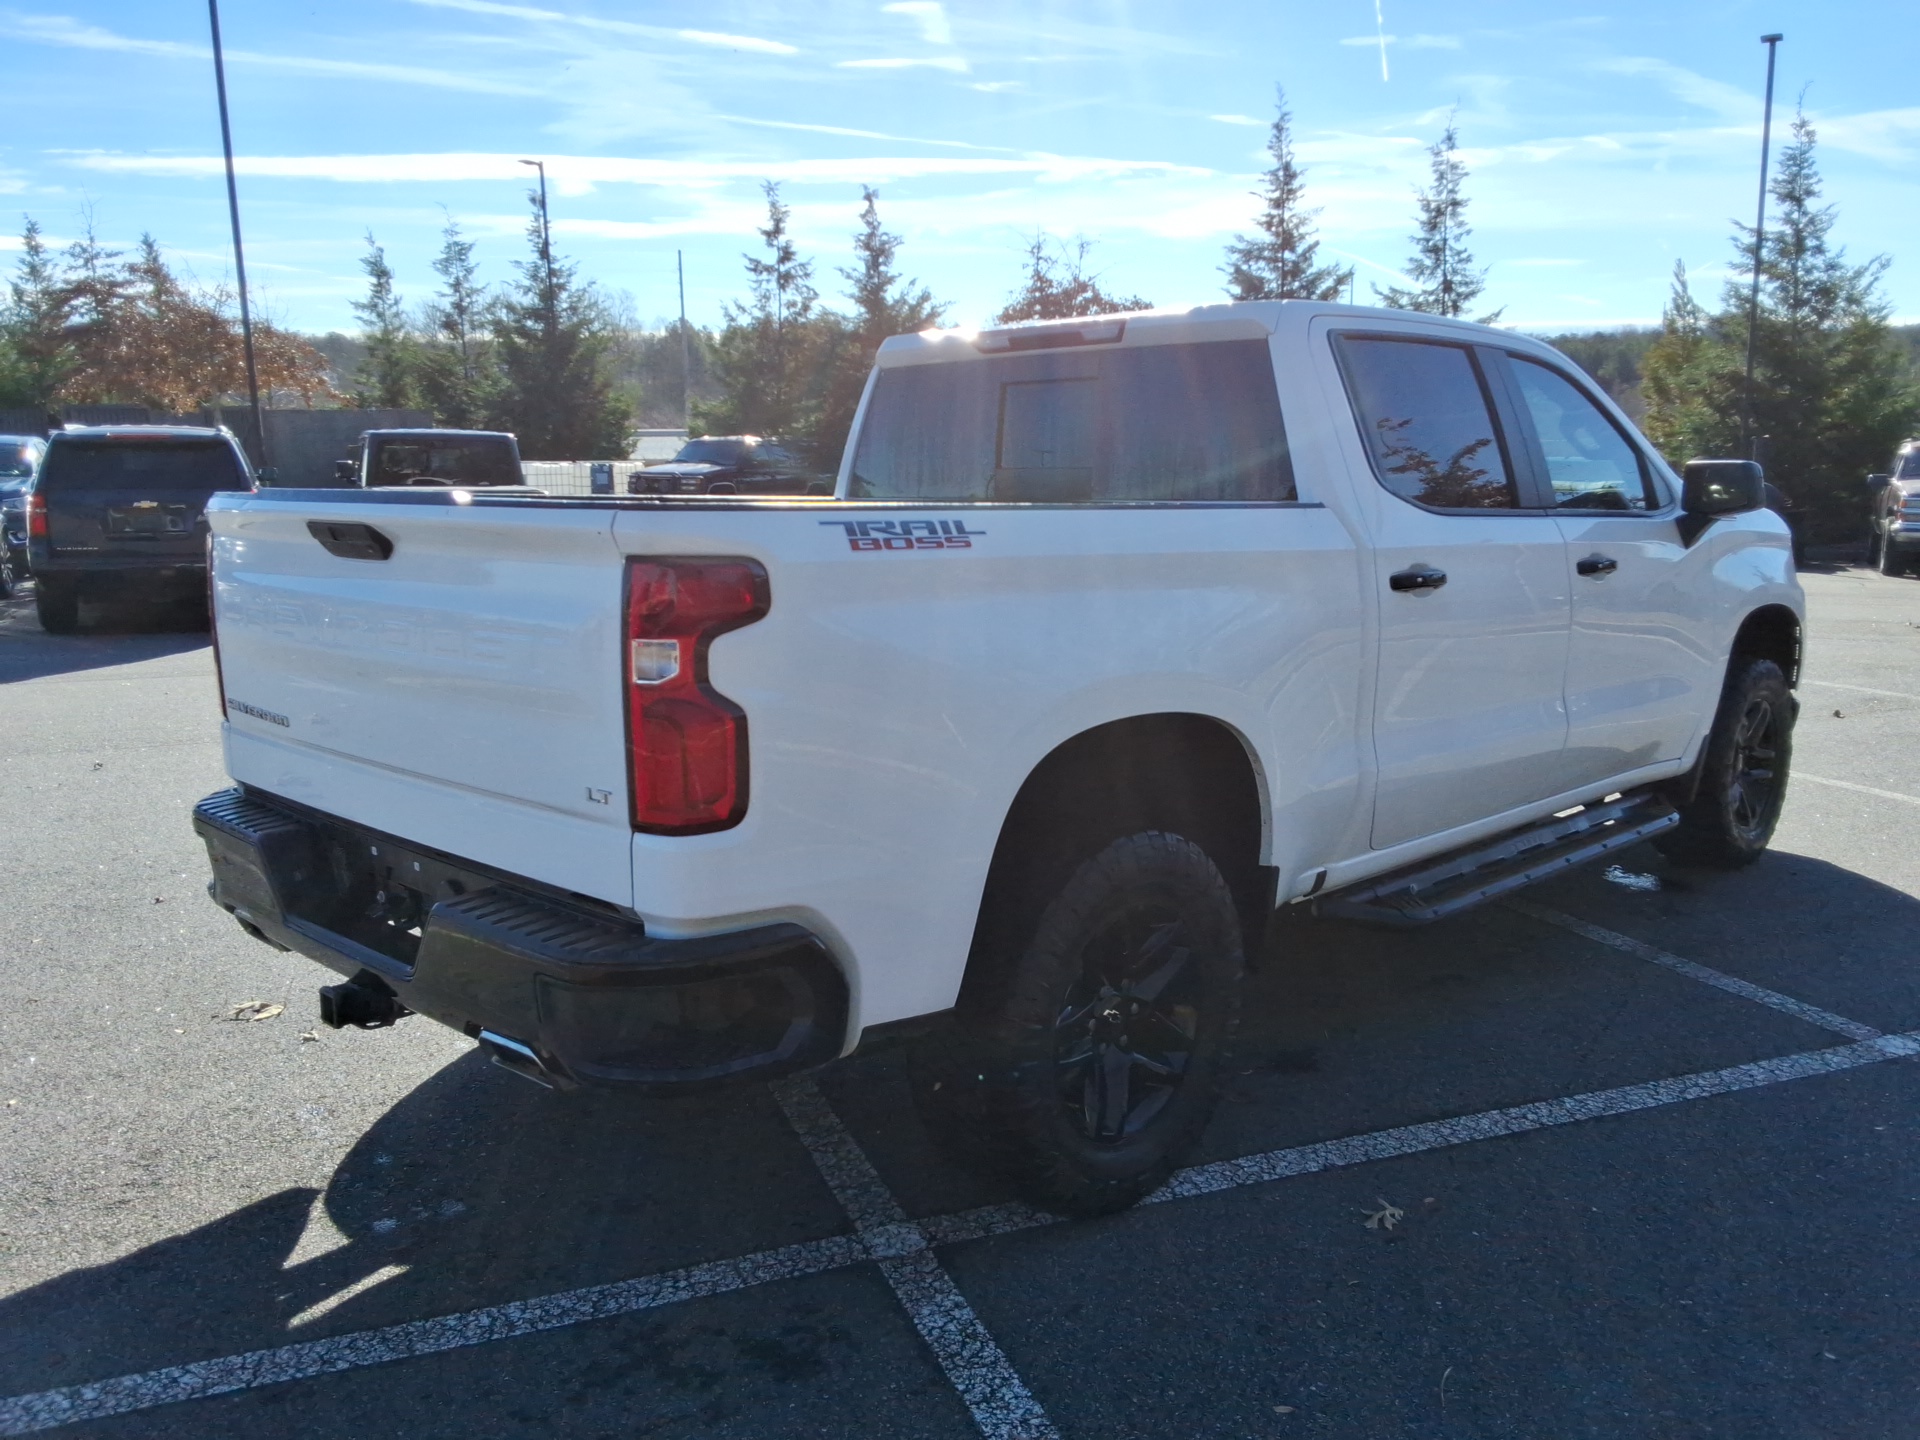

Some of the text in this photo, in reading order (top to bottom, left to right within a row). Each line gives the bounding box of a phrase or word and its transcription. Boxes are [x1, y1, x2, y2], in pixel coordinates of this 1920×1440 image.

[818, 519, 987, 537] TRAIL
[848, 535, 973, 551] BOSS
[584, 786, 613, 805] LT
